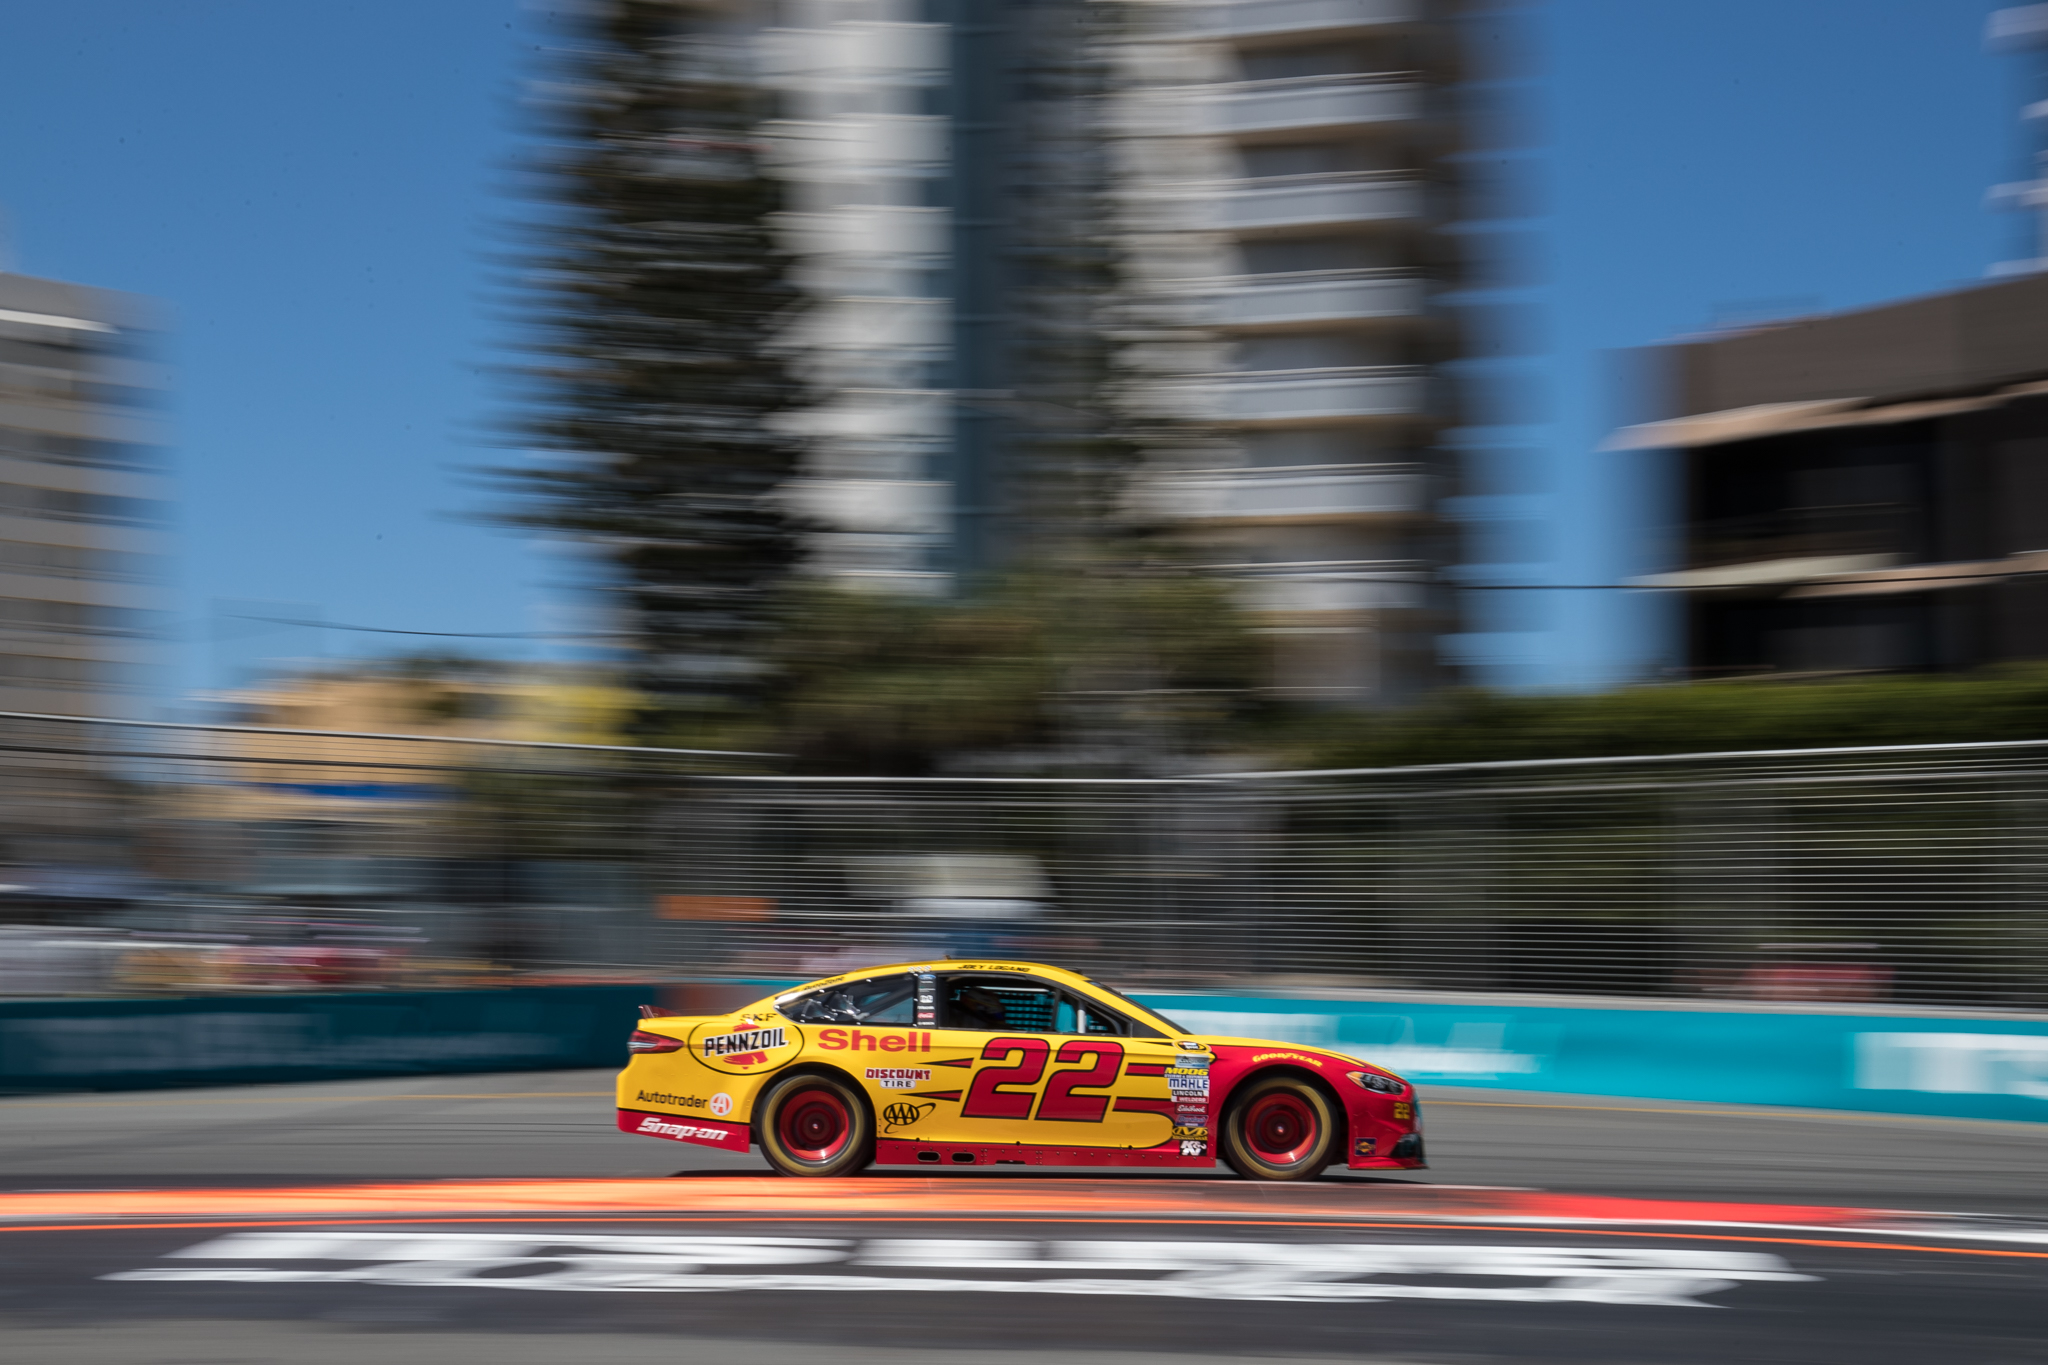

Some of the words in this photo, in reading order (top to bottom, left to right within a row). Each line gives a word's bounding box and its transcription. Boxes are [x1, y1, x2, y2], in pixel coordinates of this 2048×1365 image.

[740, 1012, 777, 1022] SKF
[703, 1026, 789, 1058] PENNZOIL
[818, 1028, 931, 1053] Shell
[1252, 1052, 1323, 1068] GOODYEAR
[865, 1068, 932, 1080] DISCOUNT
[1165, 1067, 1209, 1076] MOOG
[883, 1080, 912, 1088] TIRE
[960, 1037, 1125, 1124] 22
[1169, 1078, 1209, 1089] MAHLE
[636, 1089, 709, 1109] Autotrader
[1172, 1089, 1204, 1097] LINCOLN
[886, 1103, 919, 1125] AAA
[1394, 1102, 1410, 1119] 22
[636, 1116, 729, 1141] Snap-on
